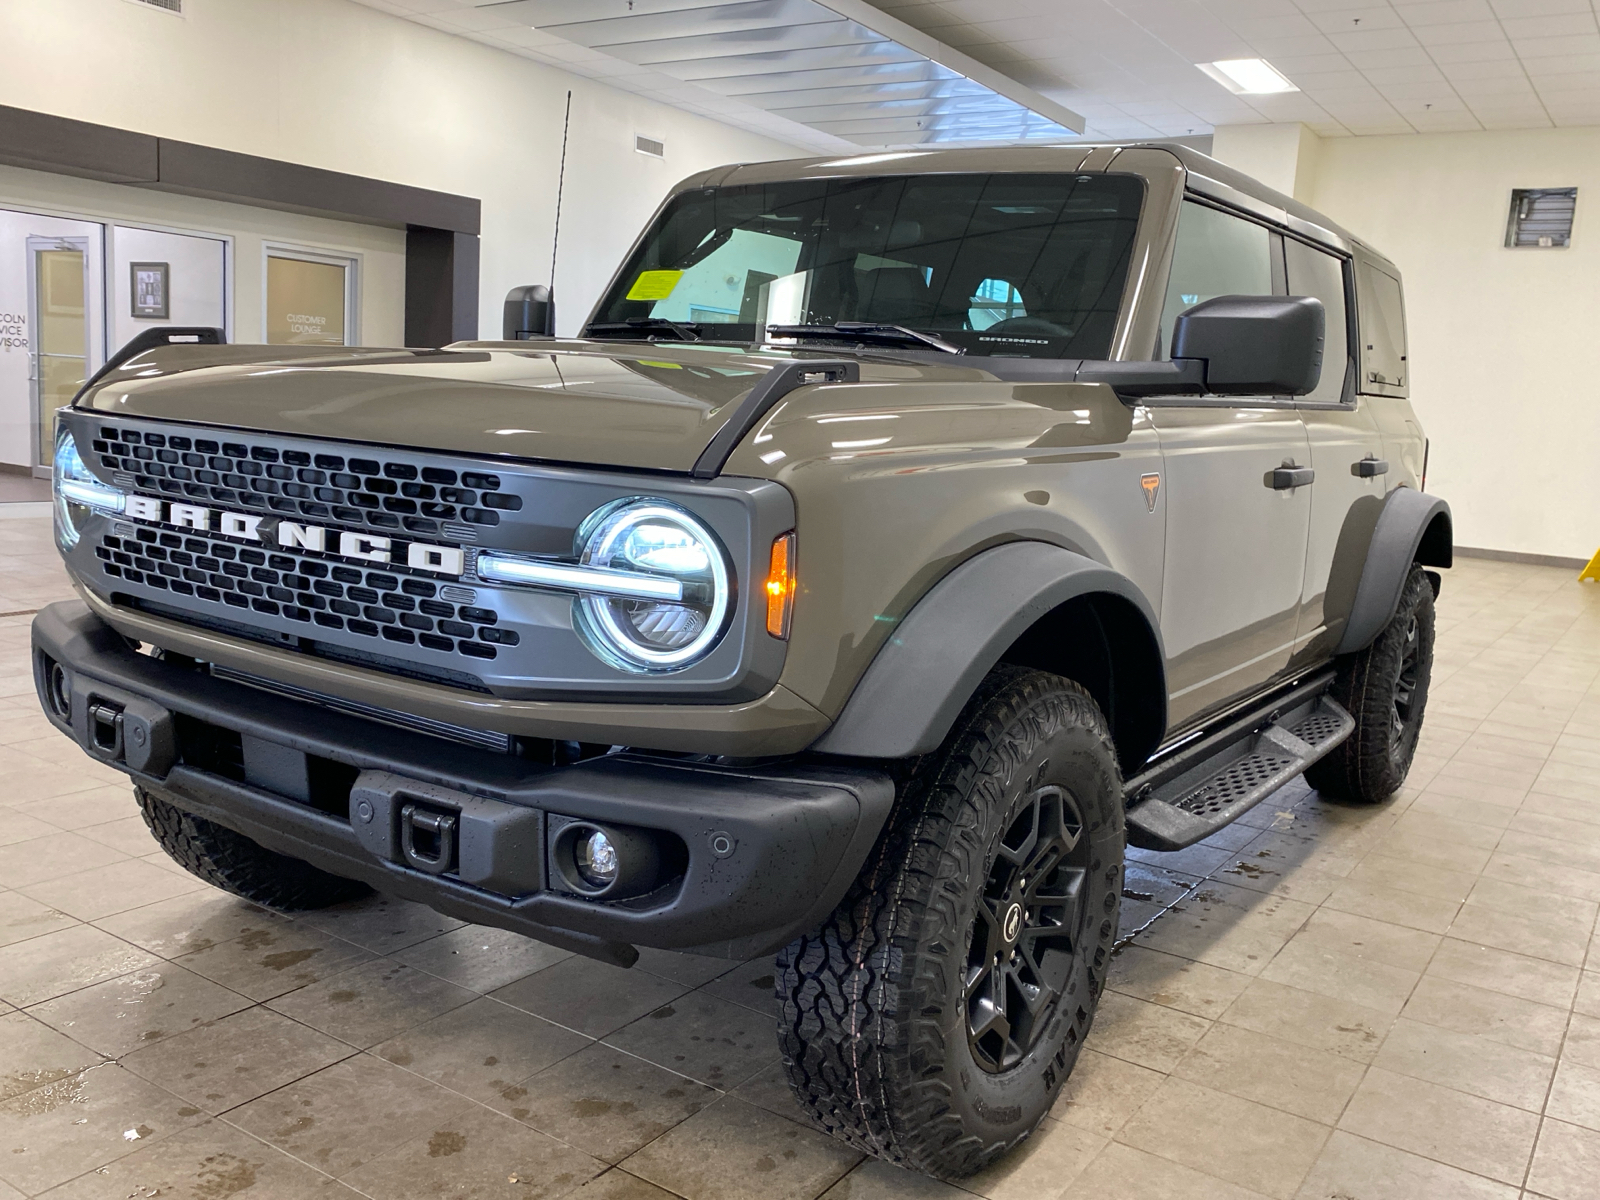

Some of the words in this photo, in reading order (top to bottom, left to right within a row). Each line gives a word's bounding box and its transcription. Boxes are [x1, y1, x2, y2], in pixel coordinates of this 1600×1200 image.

[286, 313, 326, 325] CUSTOMER
[291, 324, 321, 335] LOUNGE
[125, 494, 465, 576] BRONCO
